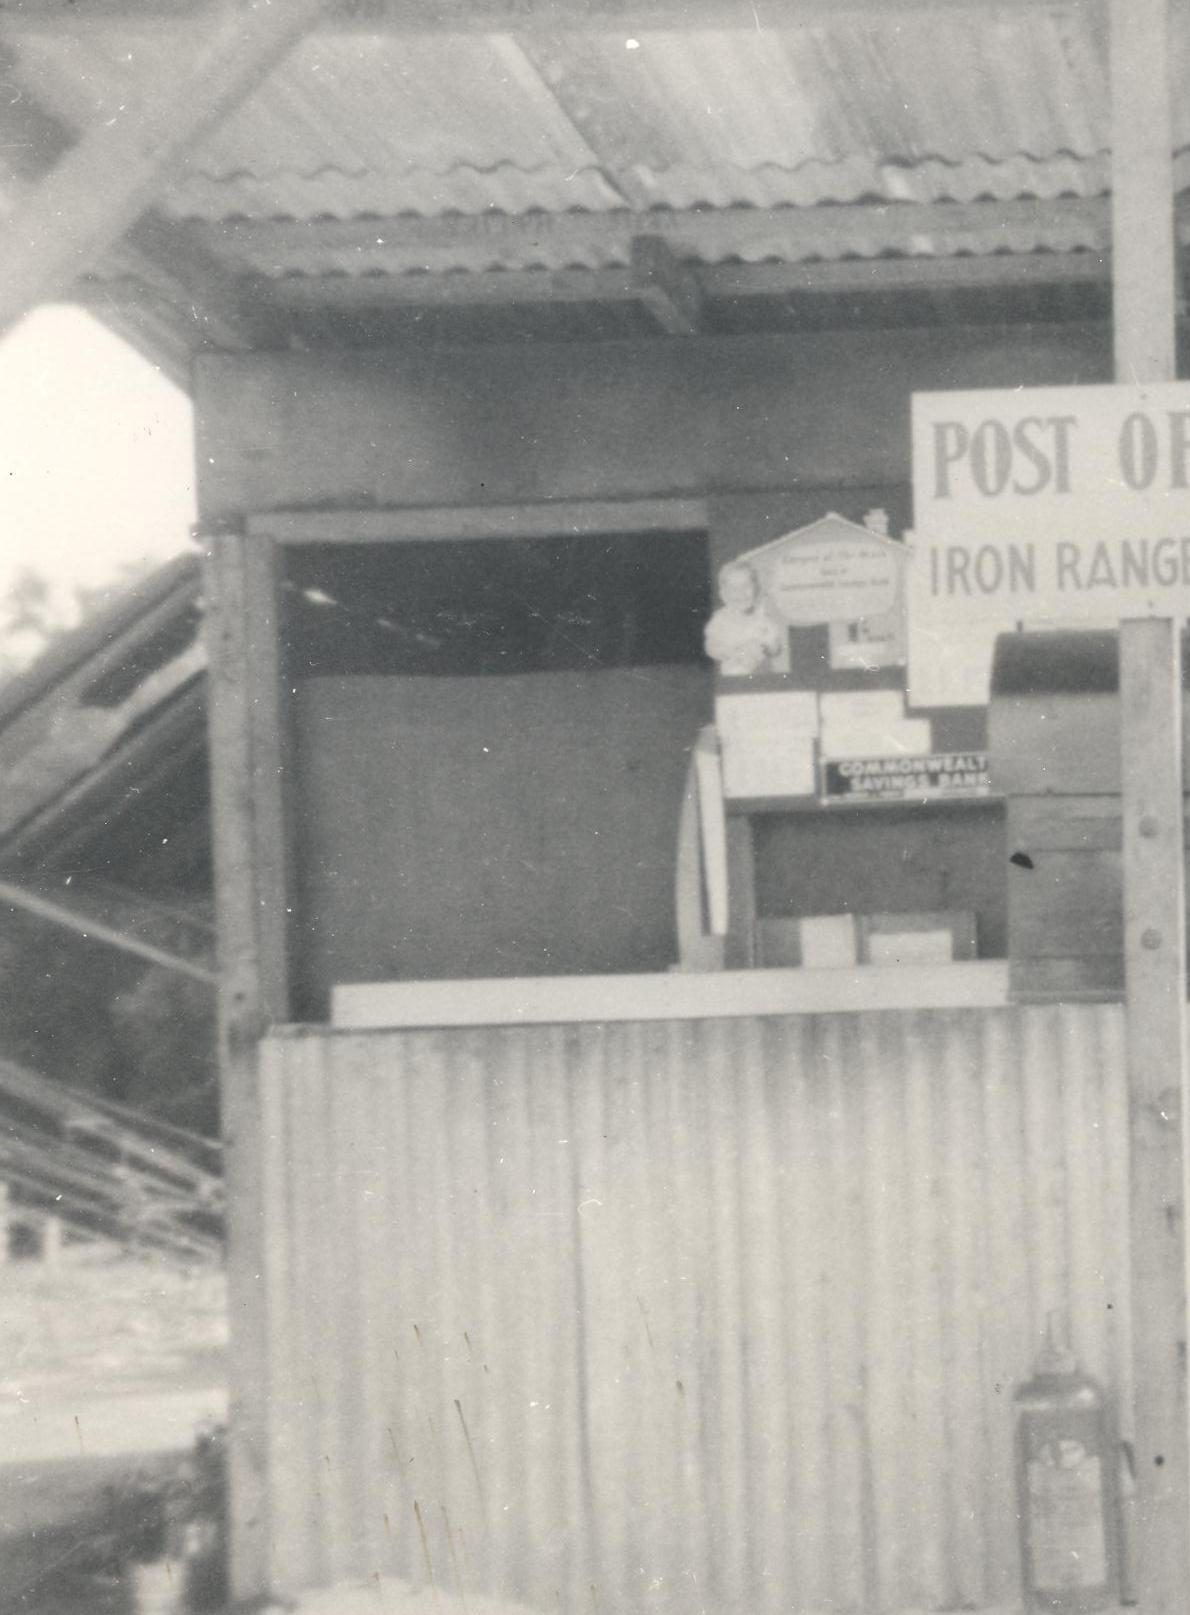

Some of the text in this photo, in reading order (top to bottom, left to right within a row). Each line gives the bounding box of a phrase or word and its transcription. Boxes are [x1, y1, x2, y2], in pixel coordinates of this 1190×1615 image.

[930, 414, 1078, 499] POST
[929, 542, 1036, 596] IRON
[838, 755, 987, 777] COMMONWEALT
[851, 773, 931, 793] SAVINGS
